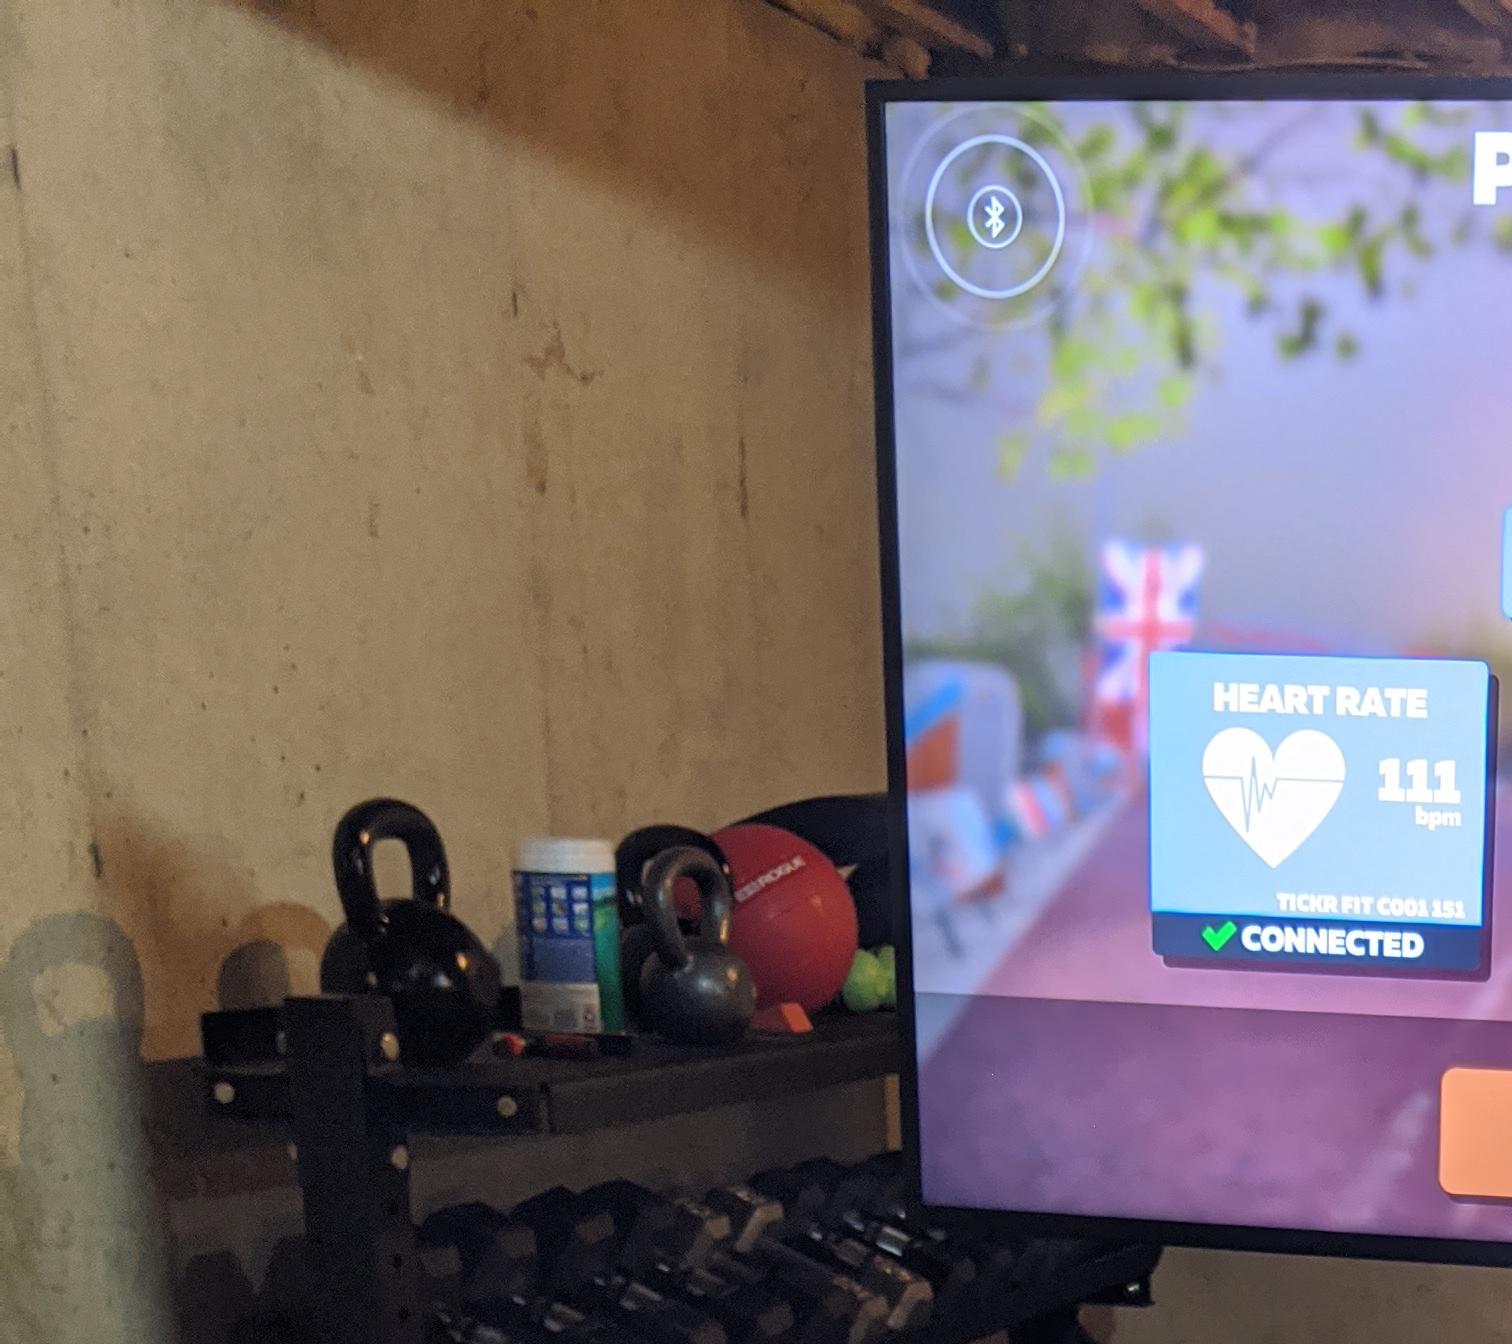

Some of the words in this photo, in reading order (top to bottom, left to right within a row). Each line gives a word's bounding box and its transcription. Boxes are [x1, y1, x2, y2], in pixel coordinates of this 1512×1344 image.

[1213, 682, 1330, 715] HEART
[1336, 687, 1428, 719] RATE
[1378, 758, 1461, 804] 111
[1415, 807, 1461, 830] bpm
[1276, 892, 1338, 913] TICKR
[1341, 895, 1375, 915] FIT
[1241, 924, 1425, 958] CONNECTED
